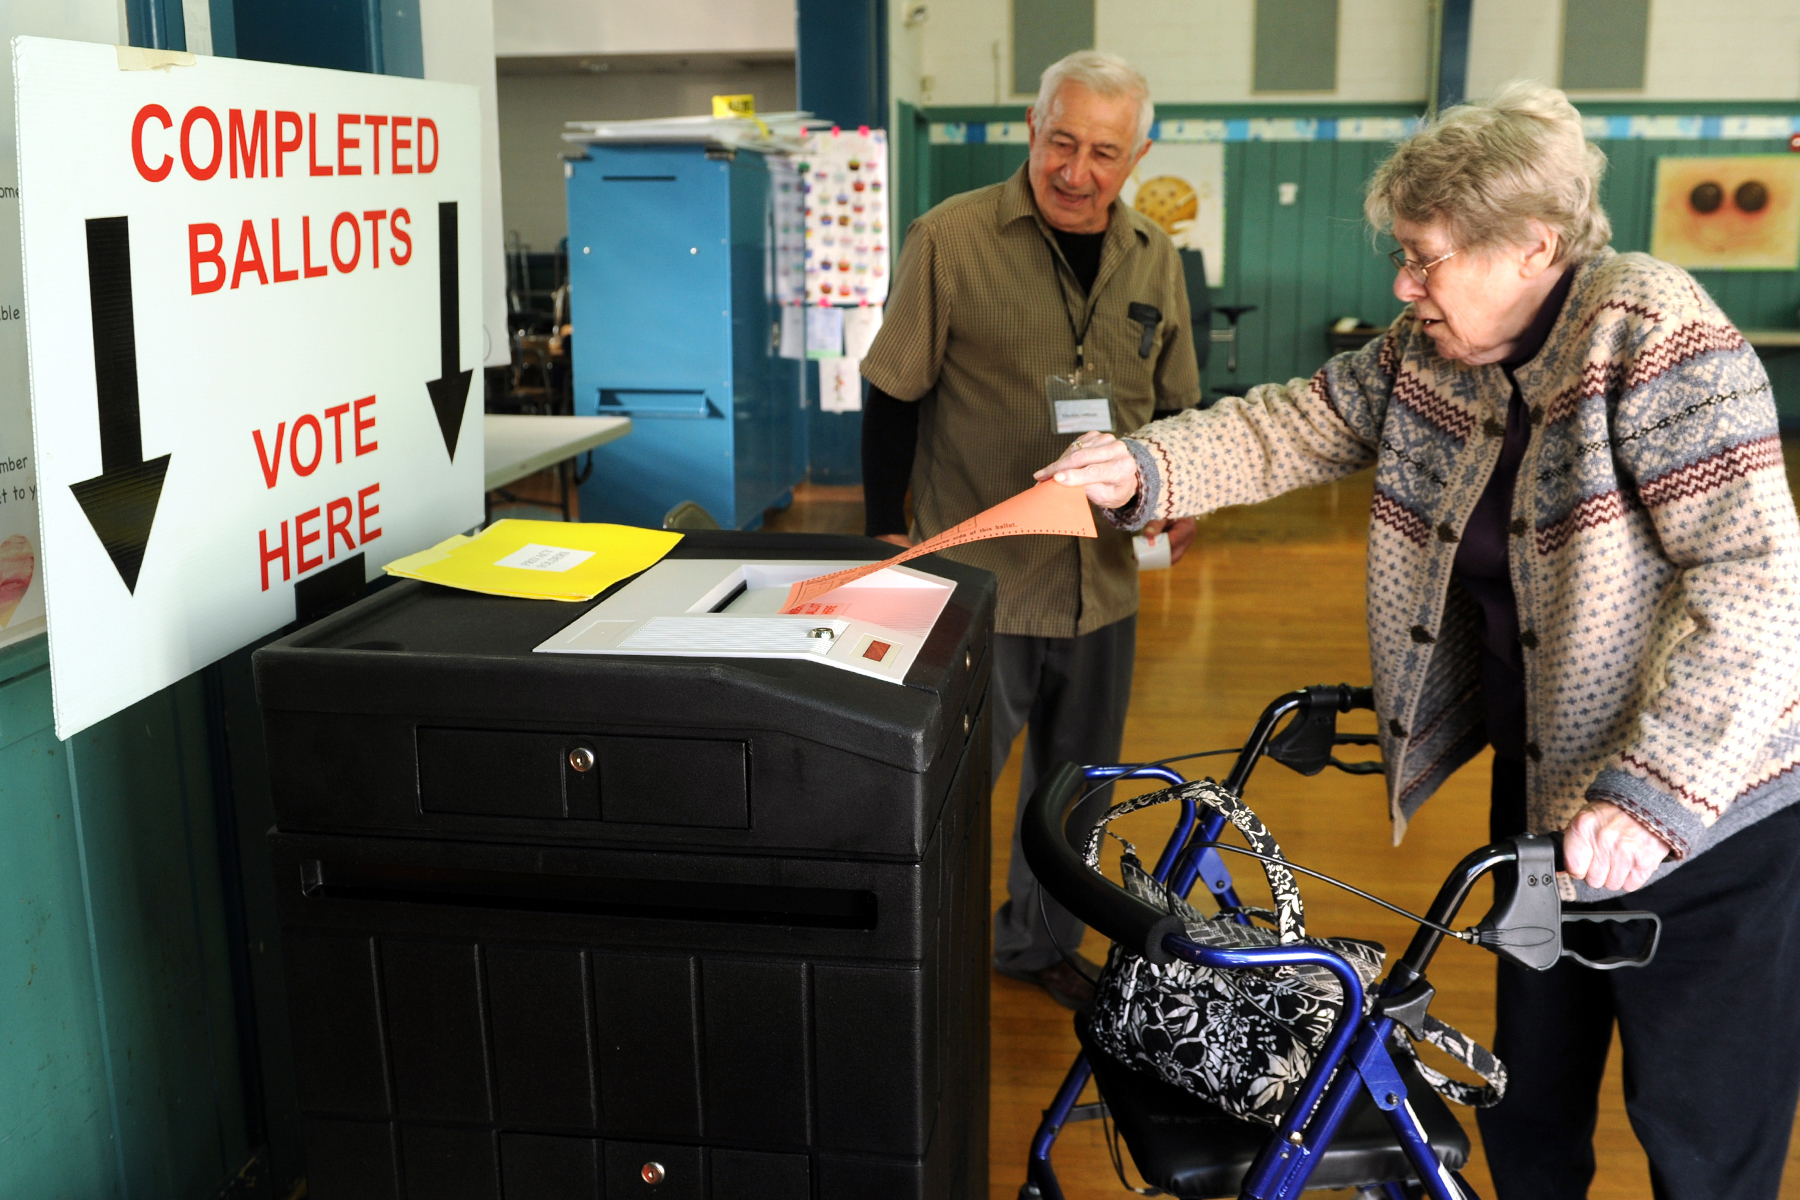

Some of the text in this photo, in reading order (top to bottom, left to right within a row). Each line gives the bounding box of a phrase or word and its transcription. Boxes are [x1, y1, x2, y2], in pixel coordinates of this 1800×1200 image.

[131, 103, 439, 183] COMPLETED
[188, 207, 413, 296] BALLOTS
[0, 304, 21, 321] ble
[252, 394, 378, 490] VOTE
[13, 486, 26, 501] to
[28, 485, 37, 501] y
[258, 482, 382, 592] HERE
